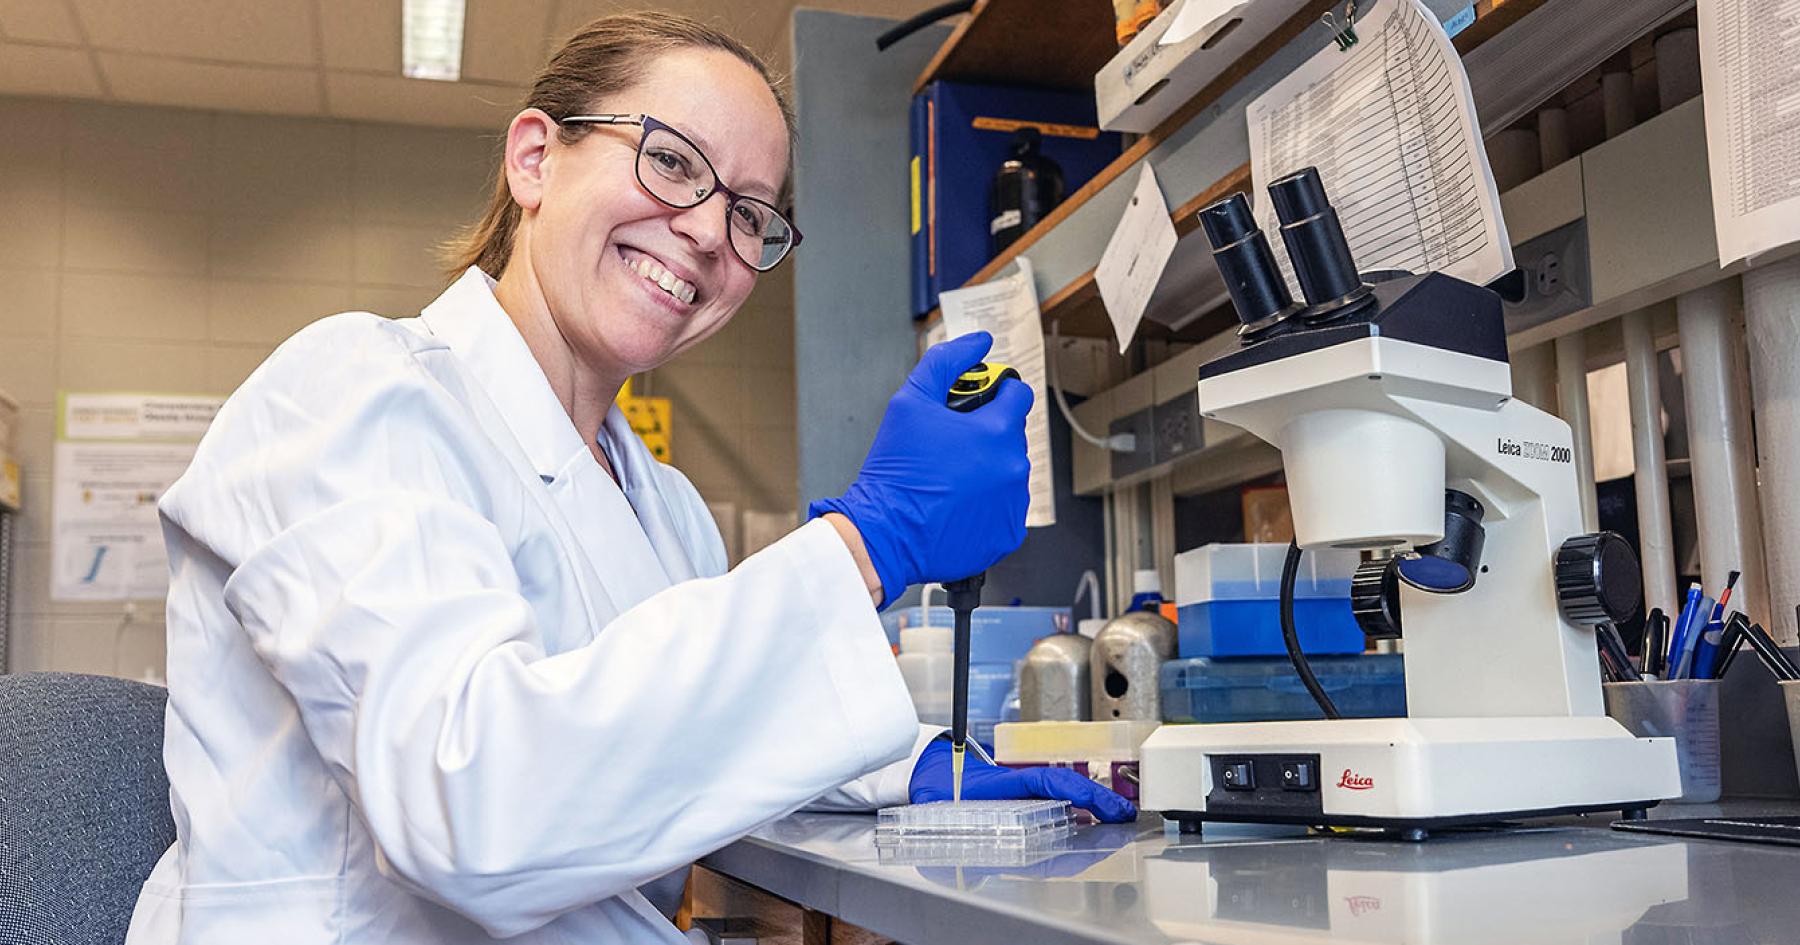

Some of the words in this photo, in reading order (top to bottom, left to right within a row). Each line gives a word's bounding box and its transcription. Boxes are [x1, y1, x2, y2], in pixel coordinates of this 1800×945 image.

[1497, 437, 1521, 456] Leica
[1550, 446, 1571, 463] 2000
[1336, 768, 1375, 790] Leica
